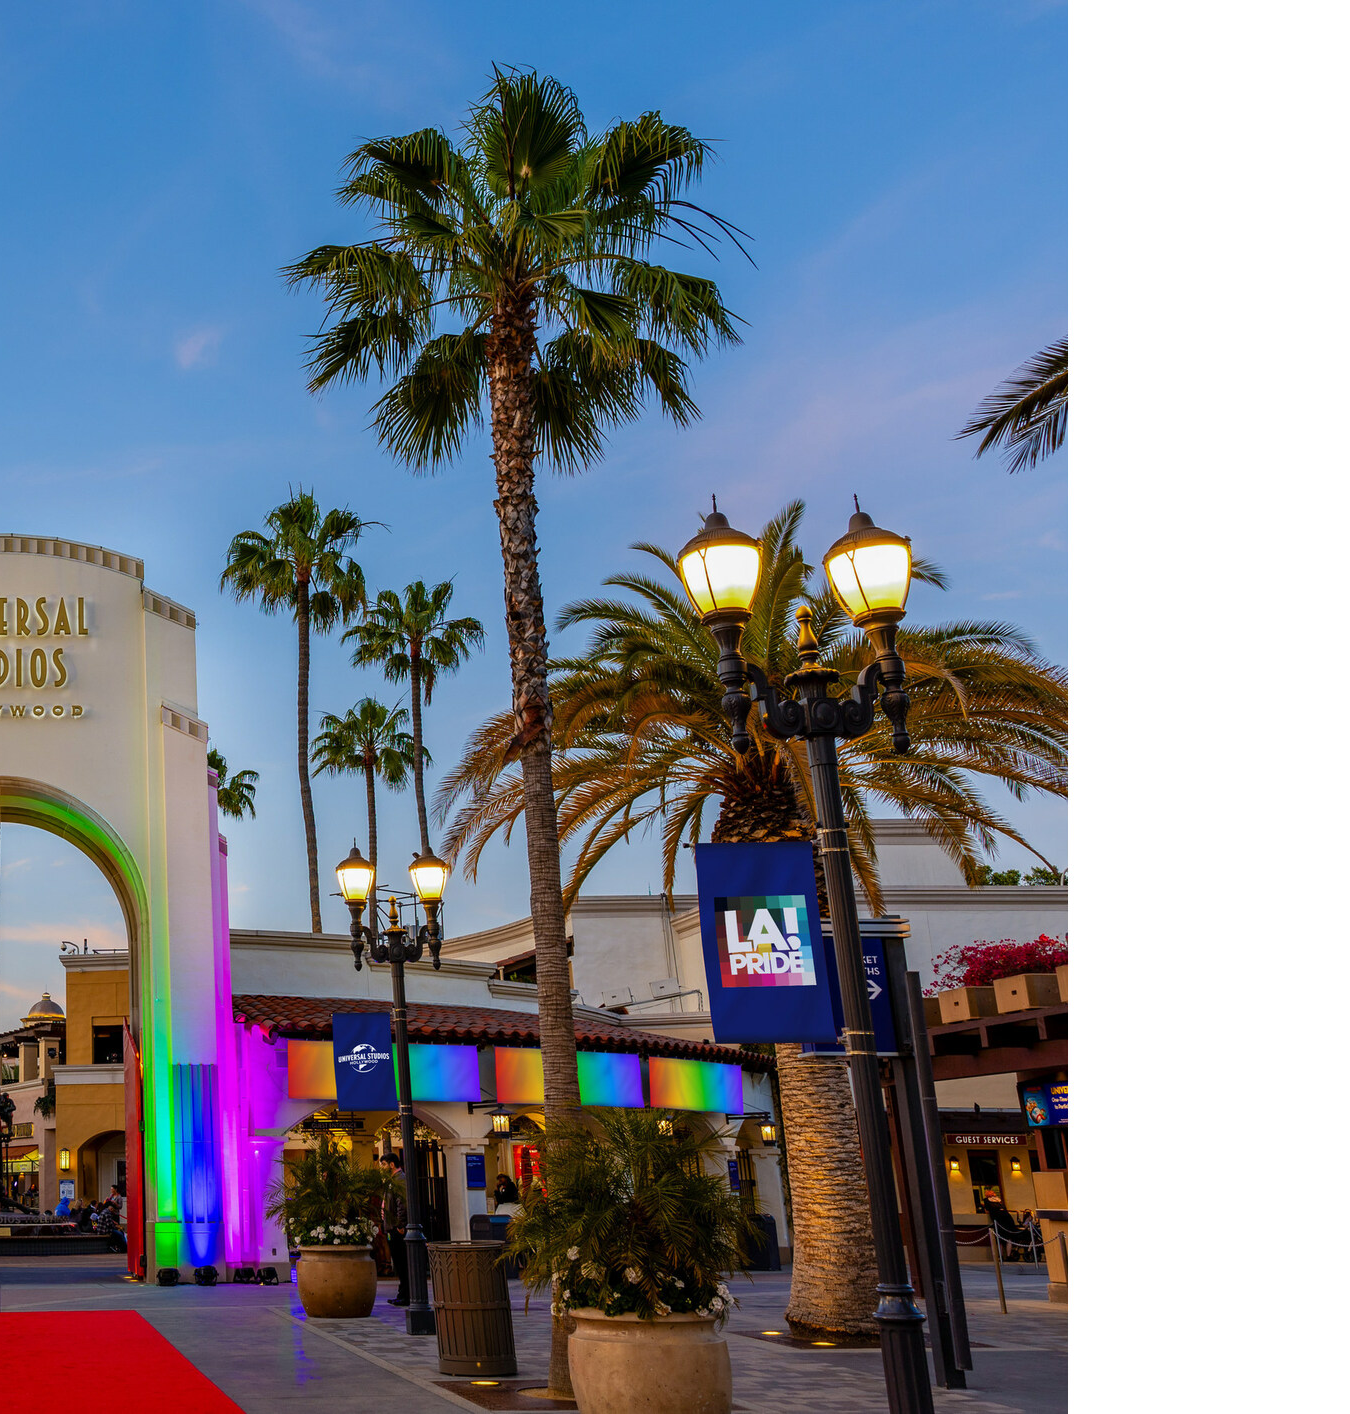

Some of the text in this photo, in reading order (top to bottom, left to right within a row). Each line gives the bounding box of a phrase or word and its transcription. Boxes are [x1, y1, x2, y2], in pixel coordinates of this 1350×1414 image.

[724, 907, 801, 953] LA!
[729, 951, 804, 975] PRIDE
[338, 1053, 366, 1063] UNIVERSAL
[1051, 1086, 1068, 1095] UNIVE
[955, 1136, 1019, 1144] GUEST SERVICES
